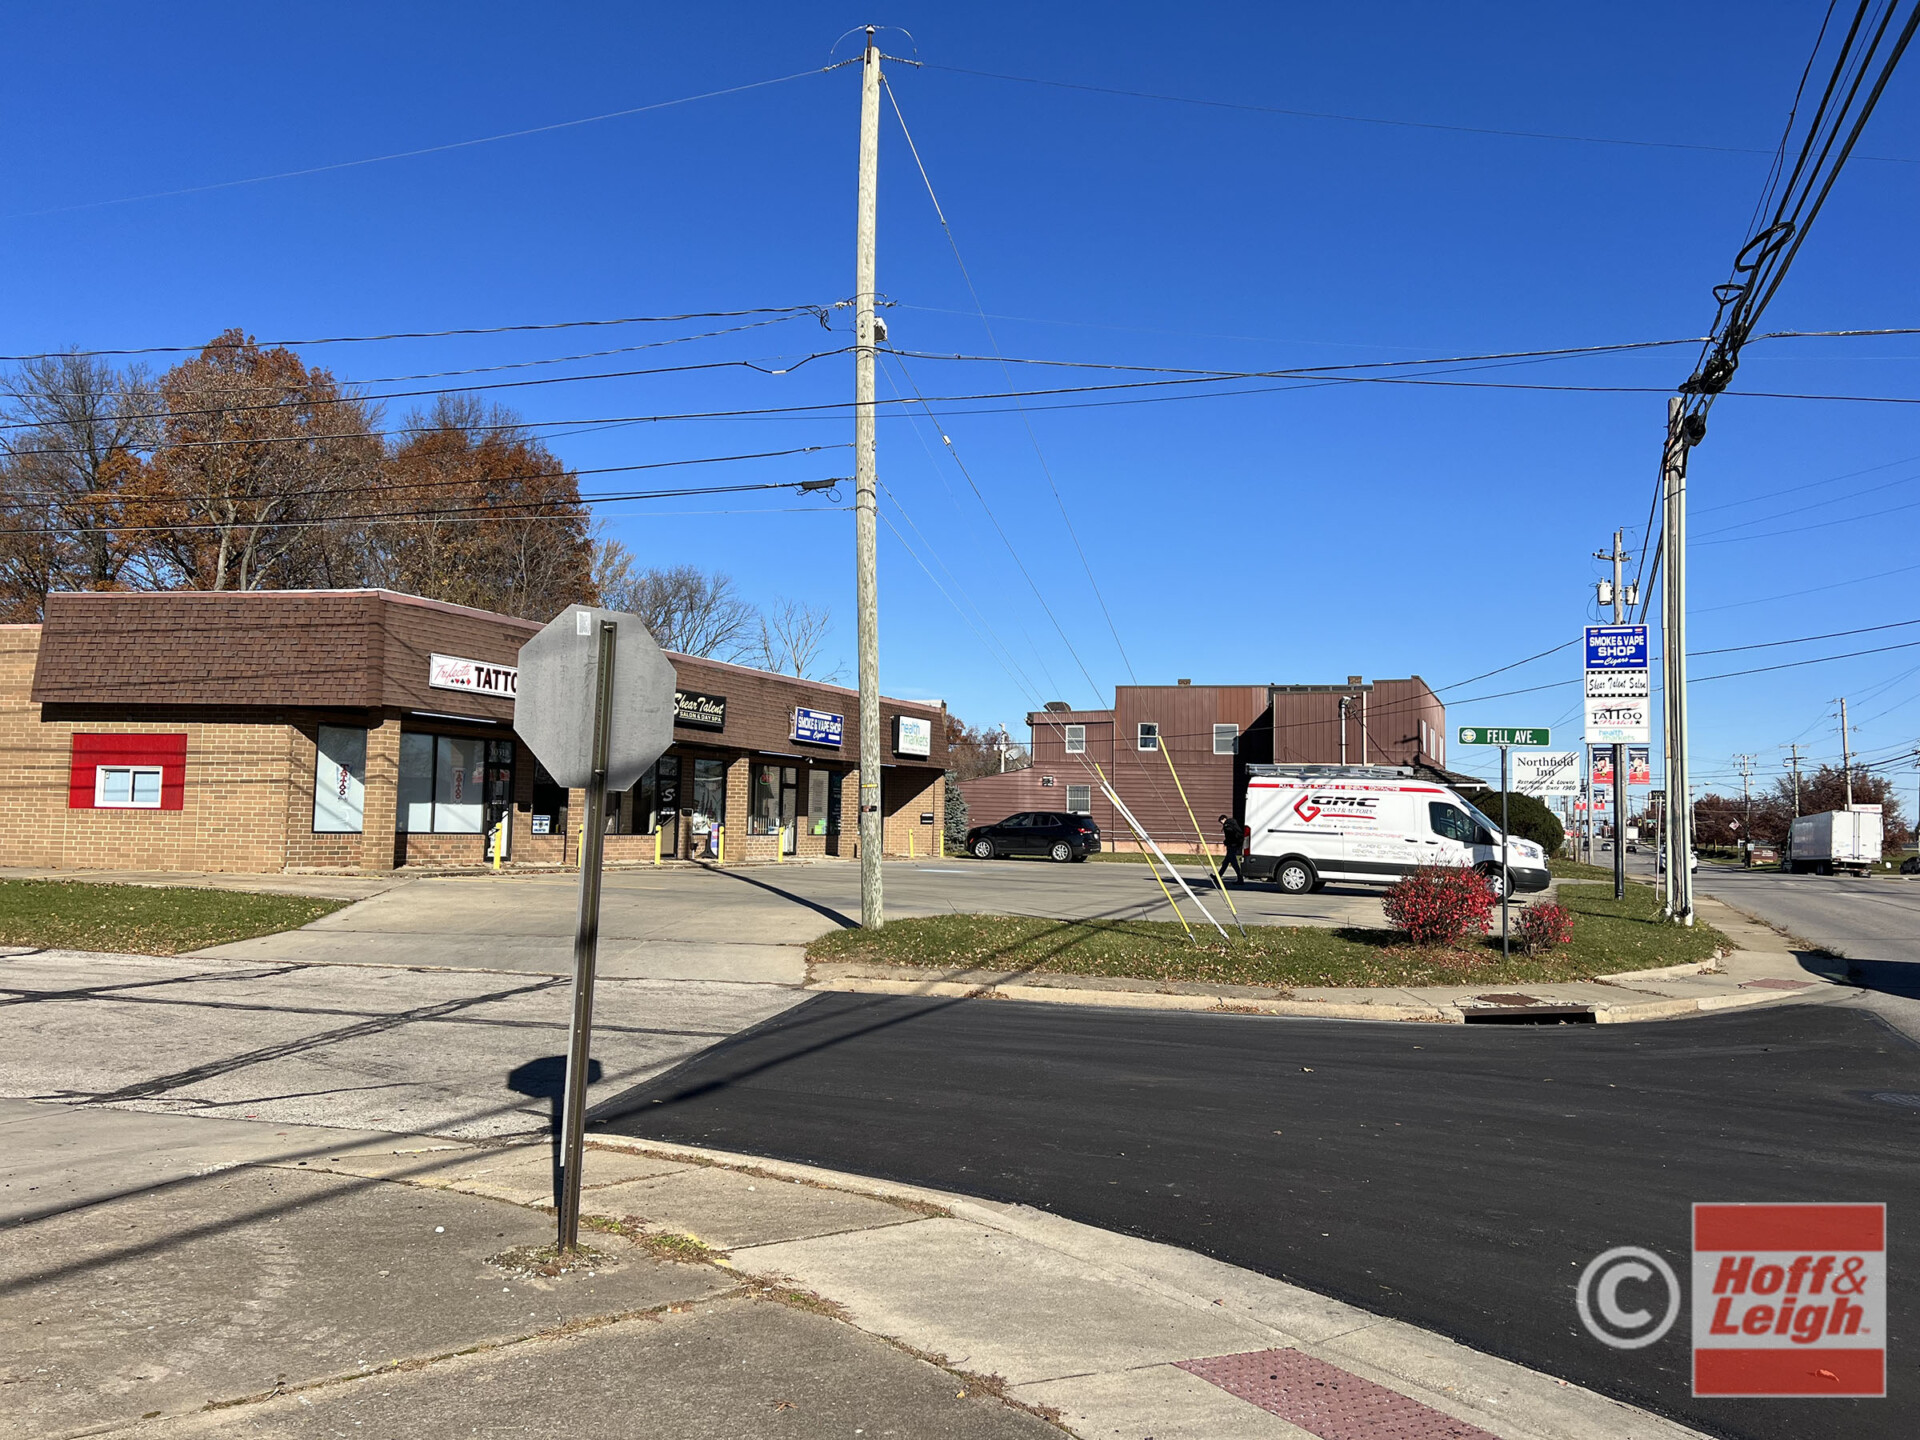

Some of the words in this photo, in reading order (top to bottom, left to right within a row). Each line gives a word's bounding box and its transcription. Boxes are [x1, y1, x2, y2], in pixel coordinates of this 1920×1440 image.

[1590, 636, 1616, 646] SMOKE
[1617, 636, 1623, 646] &
[1623, 635, 1644, 645] VAPE
[1598, 646, 1635, 656] SHOP
[1604, 657, 1628, 666] Cigars
[697, 697, 724, 714] Talent
[1591, 708, 1642, 720] TATTOO
[798, 716, 814, 730] SMOKE
[818, 719, 830, 732] VAPE
[830, 721, 841, 734] SHOP
[901, 720, 920, 735] health
[904, 734, 928, 747] markets
[1487, 730, 1510, 743] FELL
[1514, 730, 1537, 743] AVE.
[1517, 756, 1574, 767] Northfield
[1536, 767, 1555, 777] Inn
[1311, 795, 1379, 807] GMC
